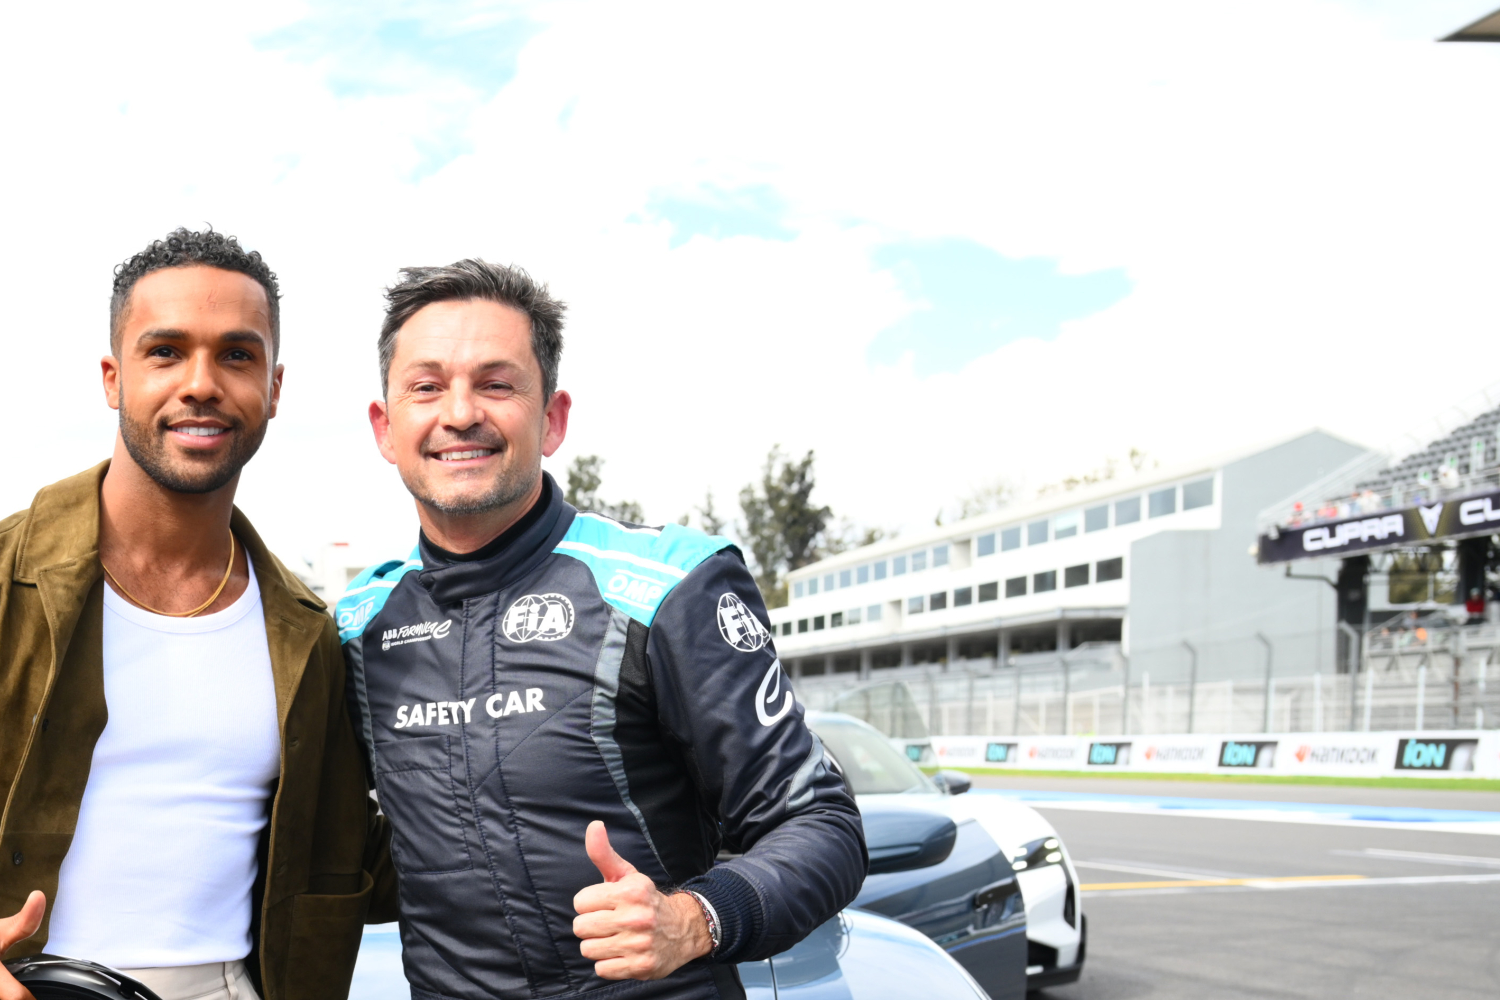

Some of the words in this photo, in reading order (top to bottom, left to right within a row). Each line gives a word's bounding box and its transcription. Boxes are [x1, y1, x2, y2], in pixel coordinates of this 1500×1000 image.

[1303, 514, 1404, 552] CUPRA
[607, 574, 663, 604] OMP
[338, 602, 374, 627] OMP
[382, 628, 398, 642] ABB
[397, 621, 438, 639] FORMULA
[394, 698, 477, 728] SAFETY
[486, 687, 546, 719] CAR
